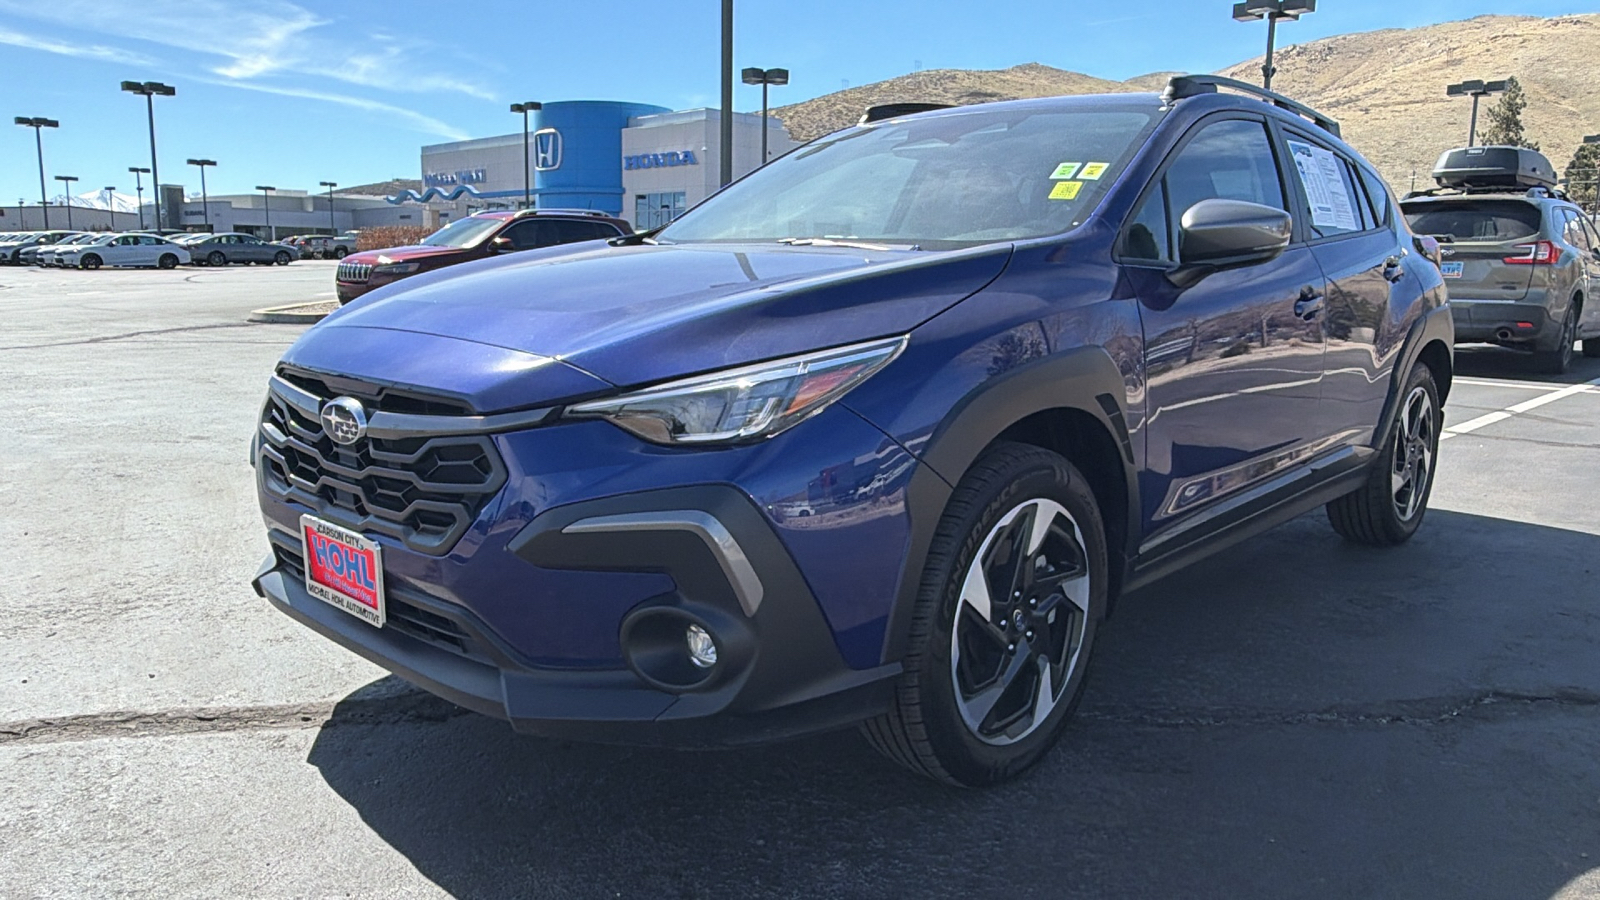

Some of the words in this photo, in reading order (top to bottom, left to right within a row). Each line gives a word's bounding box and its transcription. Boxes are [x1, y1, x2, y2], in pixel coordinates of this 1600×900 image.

[624, 150, 699, 170] HONDA
[317, 525, 344, 541] CARSON
[345, 533, 360, 547] CITY
[312, 535, 375, 591] HOHL
[308, 584, 331, 601] MICHAEL
[332, 594, 345, 608] HOHL
[346, 600, 381, 624] AUTOMOTIVE
